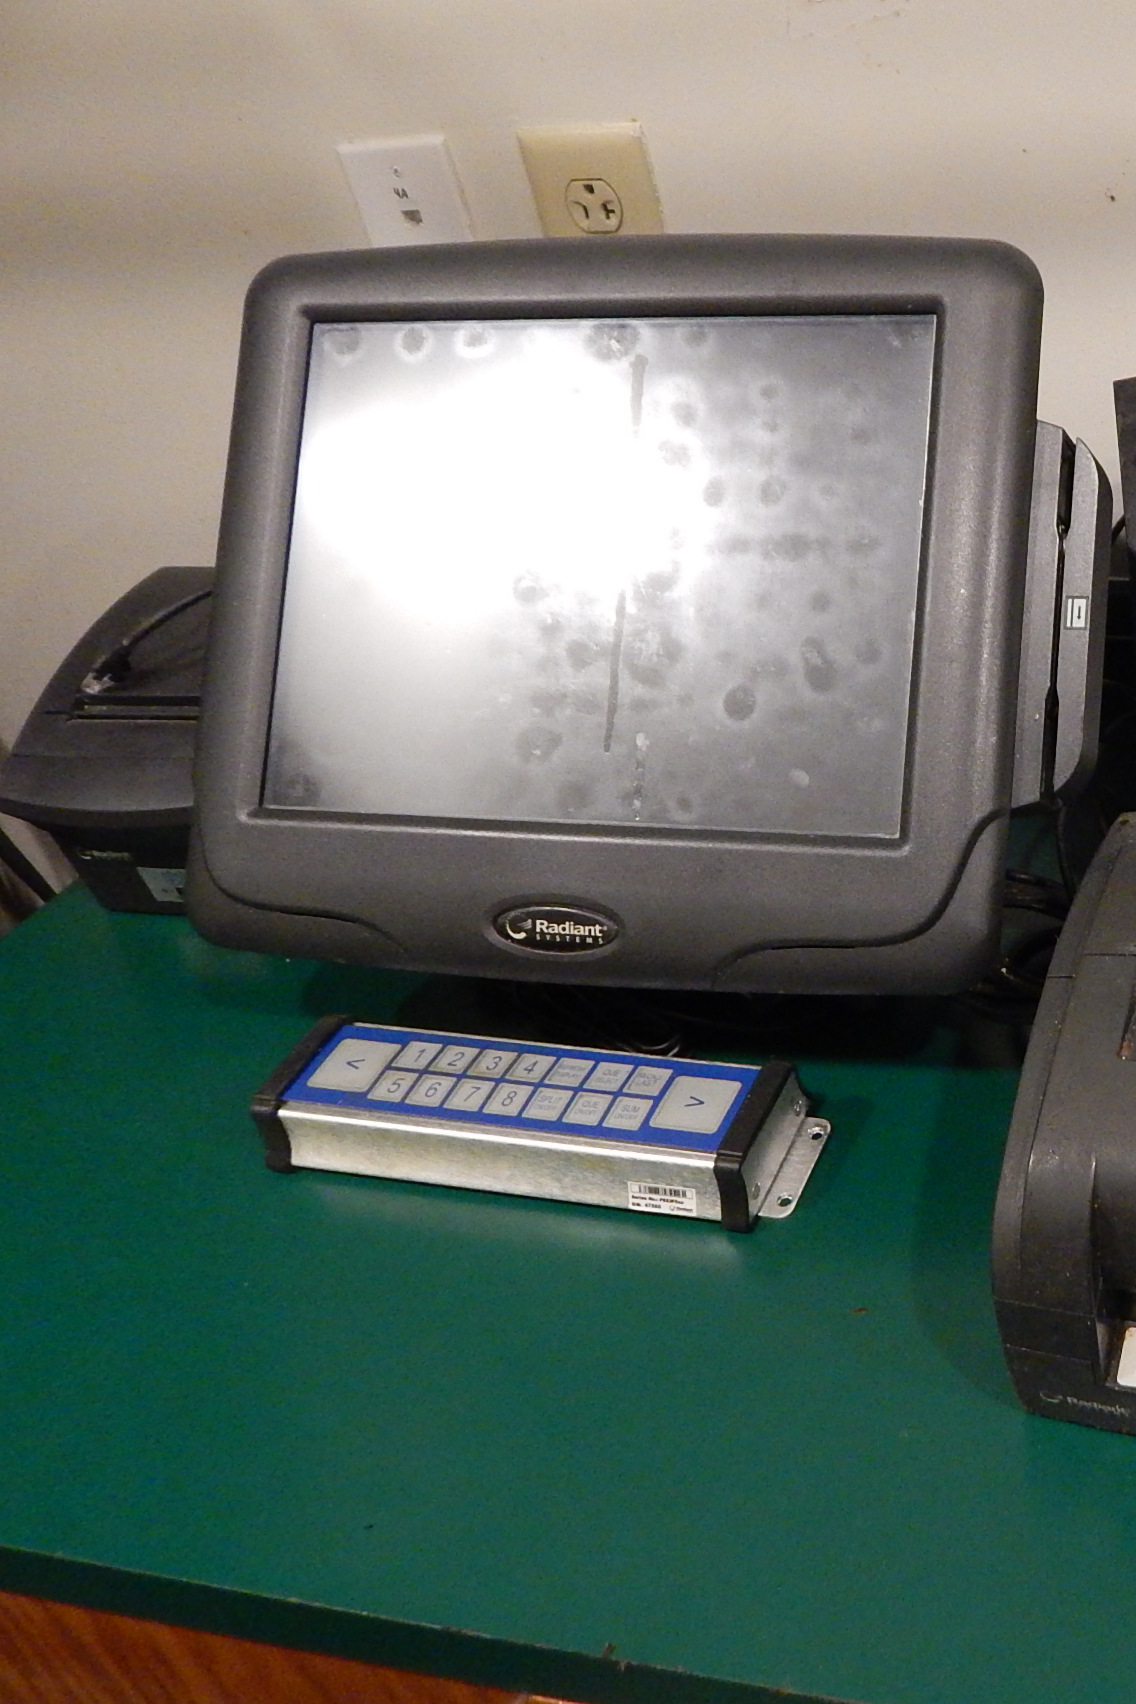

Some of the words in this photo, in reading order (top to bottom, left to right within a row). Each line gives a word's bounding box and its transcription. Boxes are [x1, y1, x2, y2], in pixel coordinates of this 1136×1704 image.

[535, 919, 603, 936] Radiant
[536, 934, 604, 944] SYSTEMS
[414, 1049, 426, 1062] 1
[447, 1051, 465, 1067] 2
[485, 1056, 502, 1071] 3
[523, 1060, 540, 1075] 4
[386, 1078, 404, 1093] 5
[424, 1082, 442, 1098] 6
[462, 1086, 480, 1102] 7
[501, 1090, 517, 1106] 8
